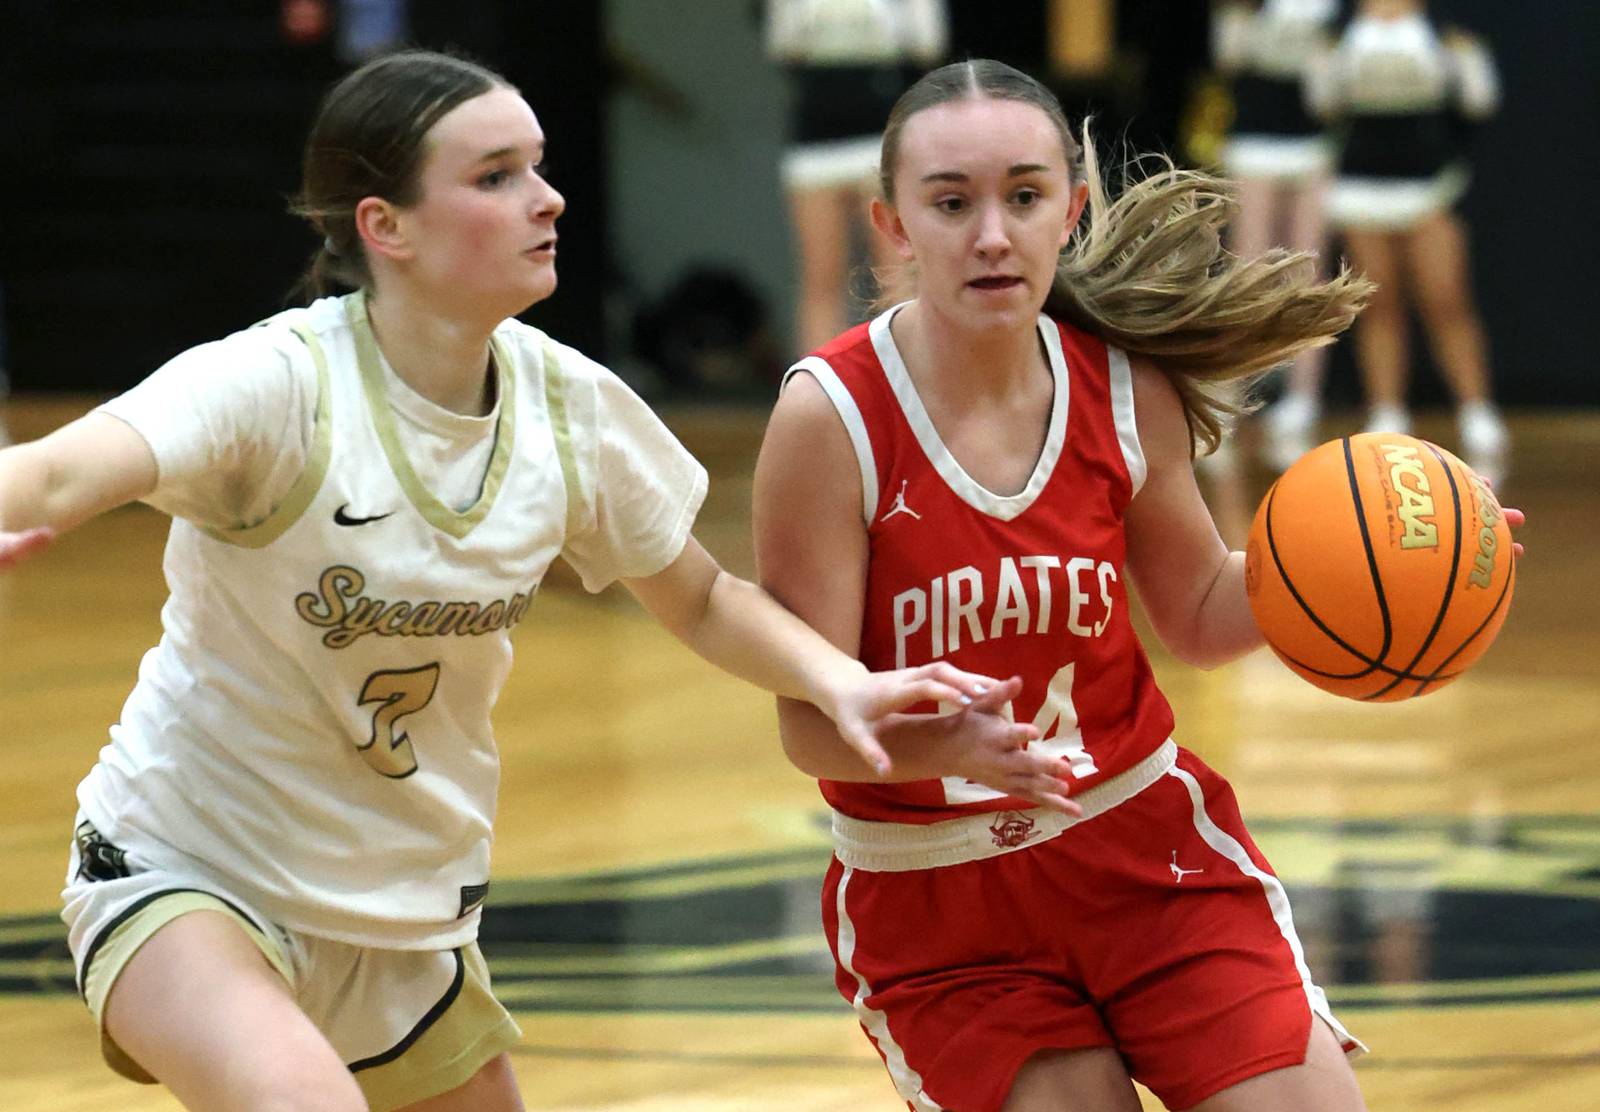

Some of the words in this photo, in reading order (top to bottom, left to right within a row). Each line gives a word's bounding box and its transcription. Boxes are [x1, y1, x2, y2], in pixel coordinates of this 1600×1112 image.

[1379, 444, 1439, 550] NCAA
[1468, 474, 1501, 589] son
[294, 564, 537, 649] Sycamor
[893, 555, 1117, 670] PIRATES
